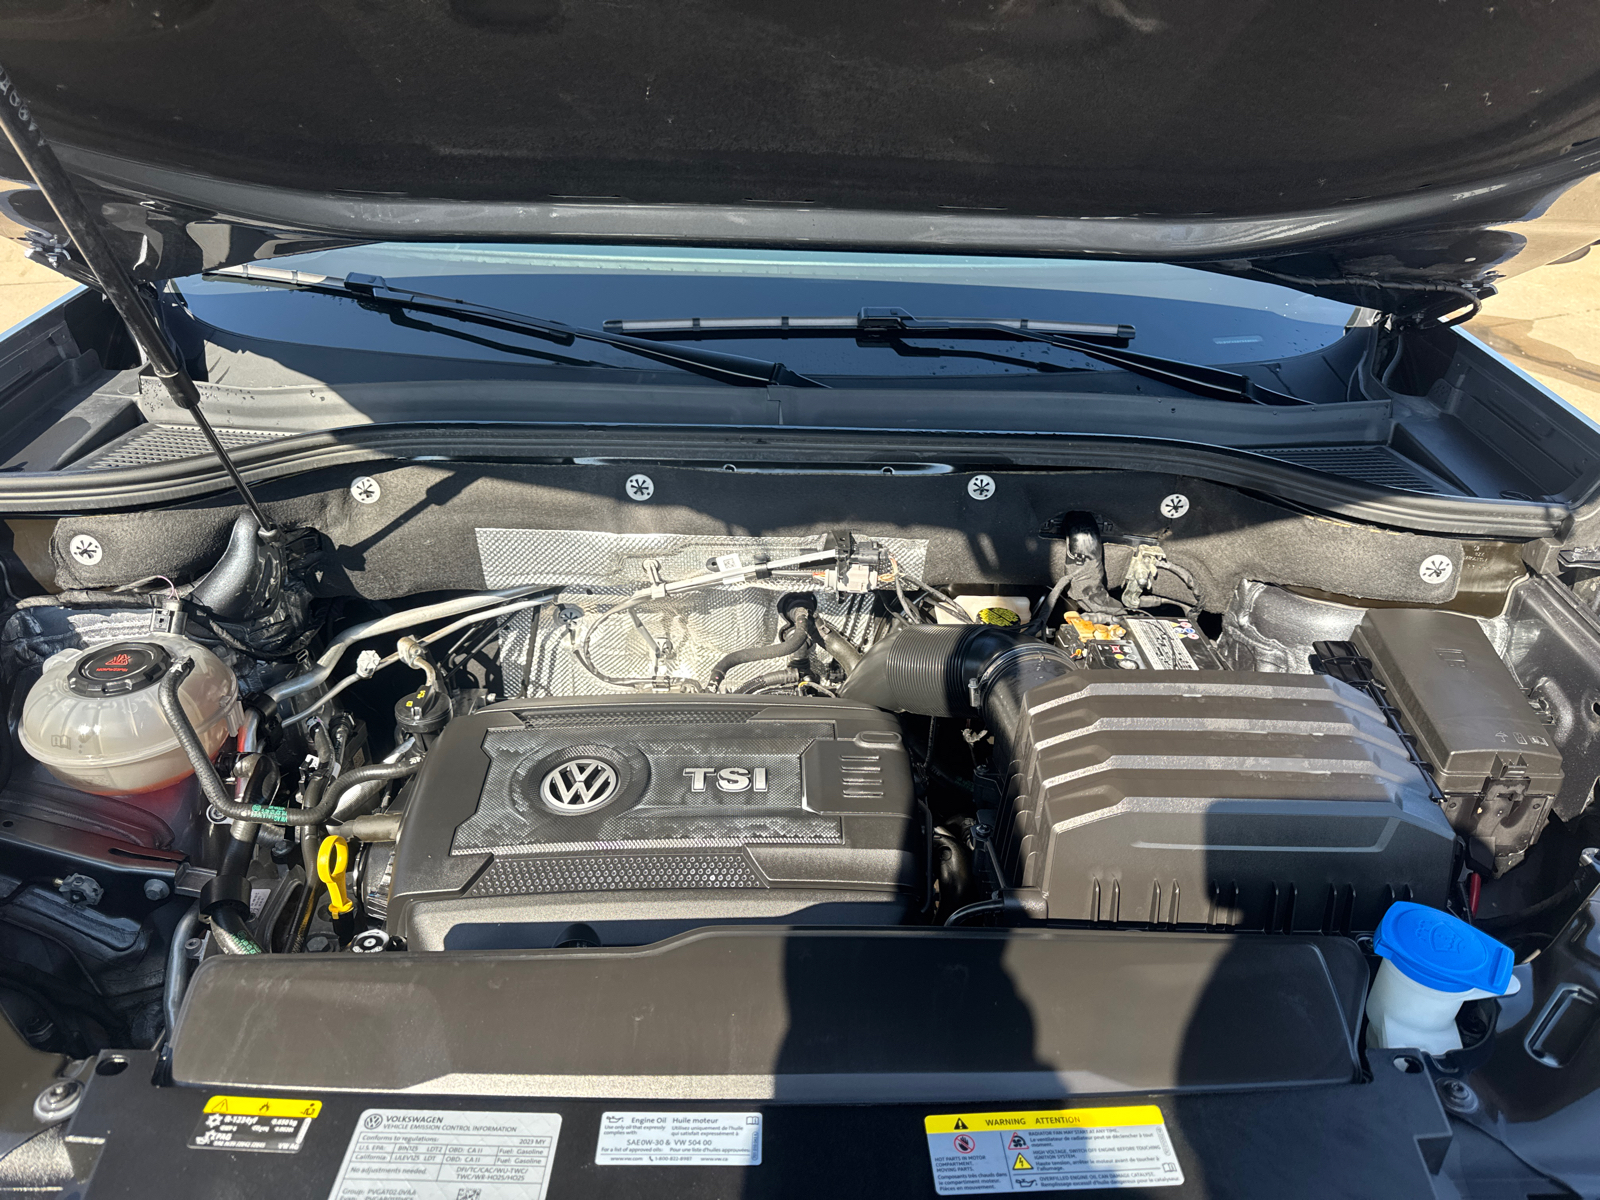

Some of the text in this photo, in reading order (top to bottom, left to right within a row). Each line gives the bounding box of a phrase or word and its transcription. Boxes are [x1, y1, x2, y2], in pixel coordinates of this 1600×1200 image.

[682, 766, 770, 794] TSI
[386, 1115, 444, 1123] VOLKSWAGEN
[631, 1117, 655, 1125] Engine
[985, 1116, 1080, 1126] WARNING ATTENTION
[472, 1125, 517, 1133] INFORMATION
[402, 1135, 439, 1143] regulations:
[278, 1142, 290, 1150] VW
[361, 1167, 401, 1175] adjustments
